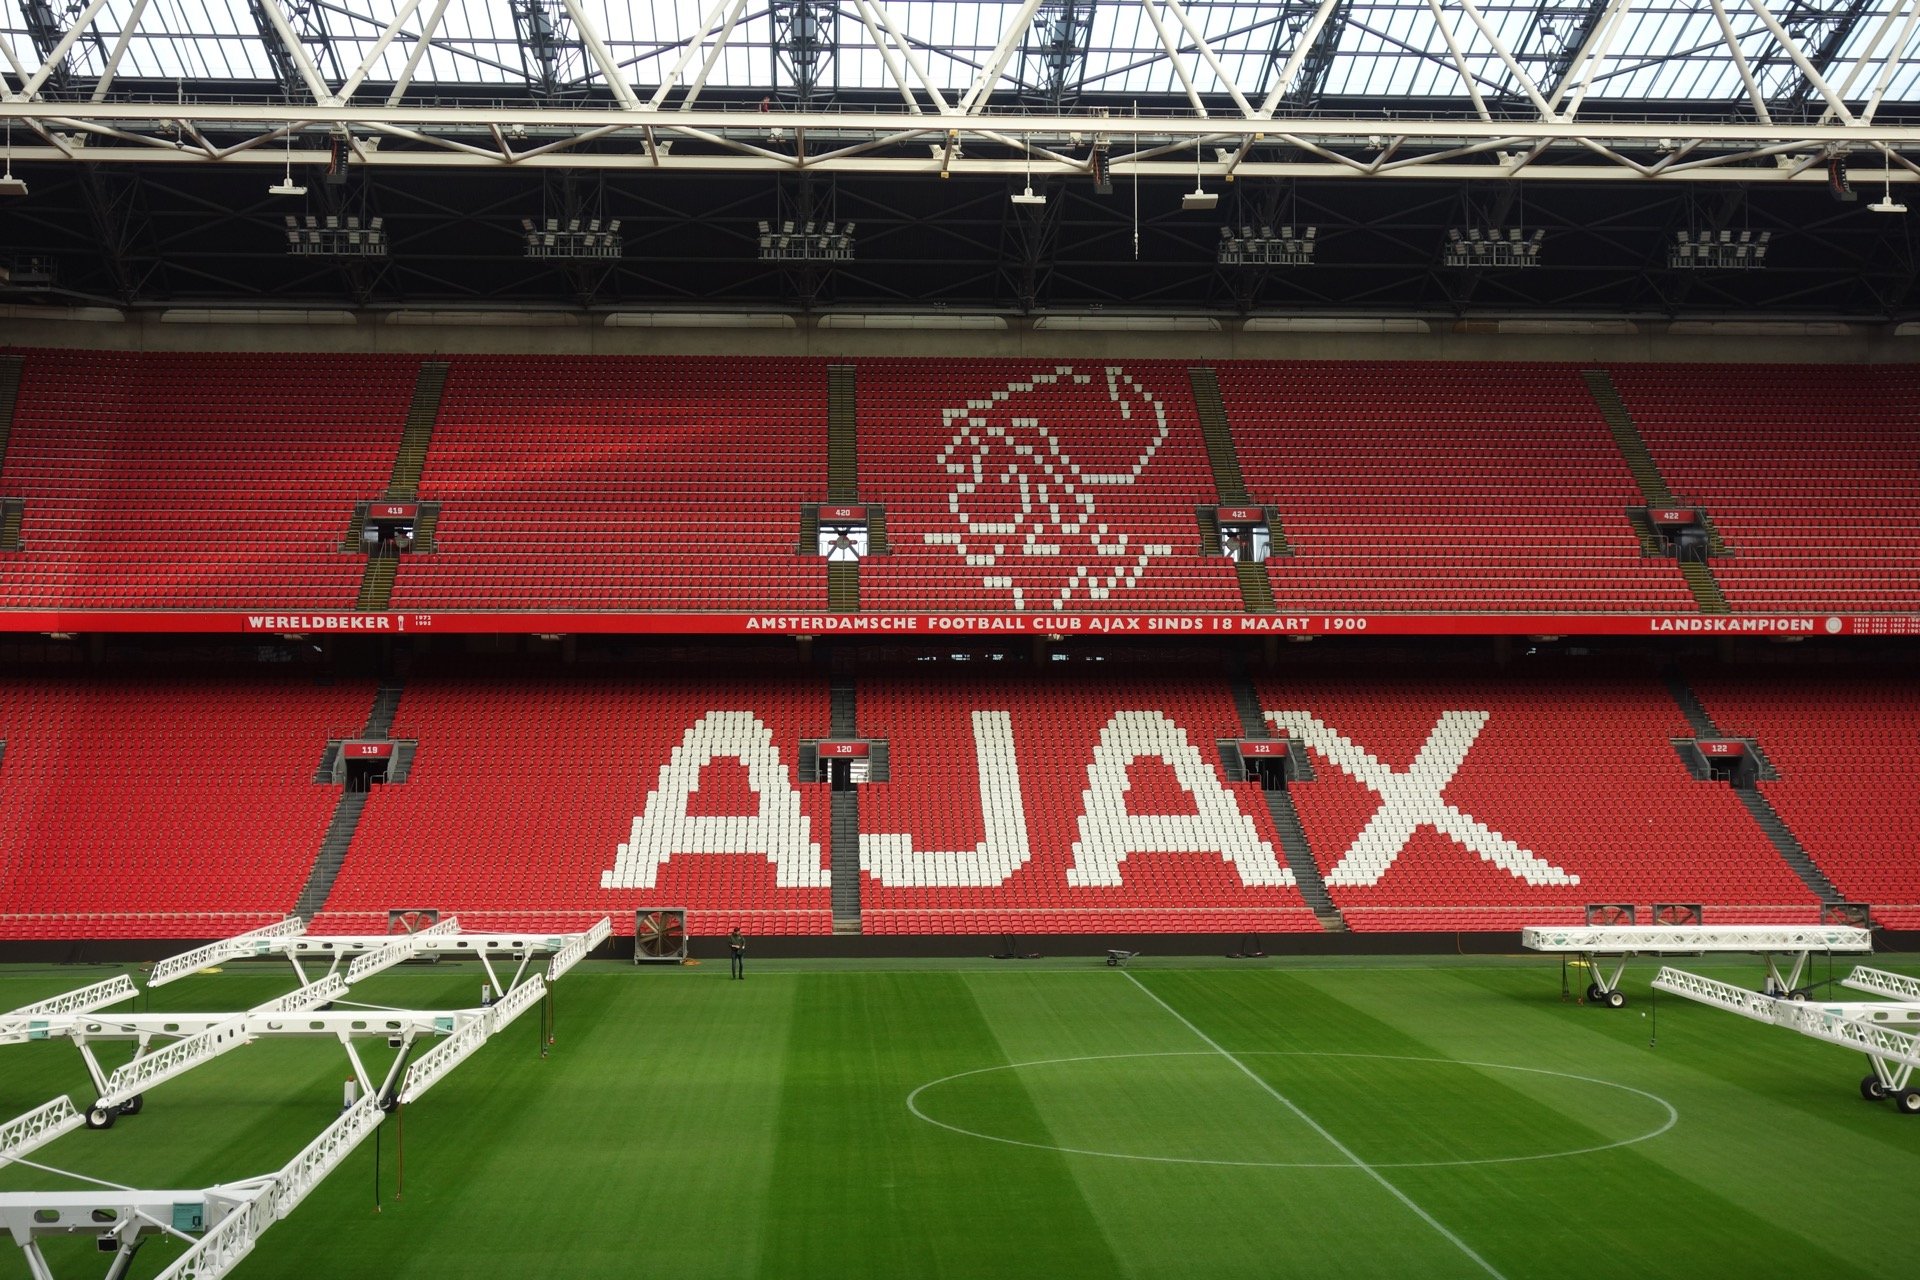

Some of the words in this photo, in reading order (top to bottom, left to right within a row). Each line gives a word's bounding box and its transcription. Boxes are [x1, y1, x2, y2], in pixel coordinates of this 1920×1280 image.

[387, 507, 403, 515] 419
[835, 509, 851, 517] 420
[1232, 510, 1247, 518] 421
[1664, 512, 1679, 520] 422
[248, 616, 390, 629] WERELDBEKER
[746, 617, 917, 630] AMSTERDAMSCHE
[928, 617, 1025, 630] FOOTBALL
[1033, 617, 1082, 630] CLUB
[1089, 617, 1140, 632] AJAX
[1148, 617, 1203, 630] SINDS
[1212, 618, 1233, 630] 18
[1241, 618, 1310, 630] MAART
[1324, 618, 1367, 630] 1900
[1651, 619, 1815, 631] LANDSKAMPIOEN
[362, 746, 378, 754] 119
[836, 745, 852, 753] 120
[1255, 745, 1270, 753] 121
[1712, 744, 1727, 752] 122
[601, 710, 1581, 890] AJAX
